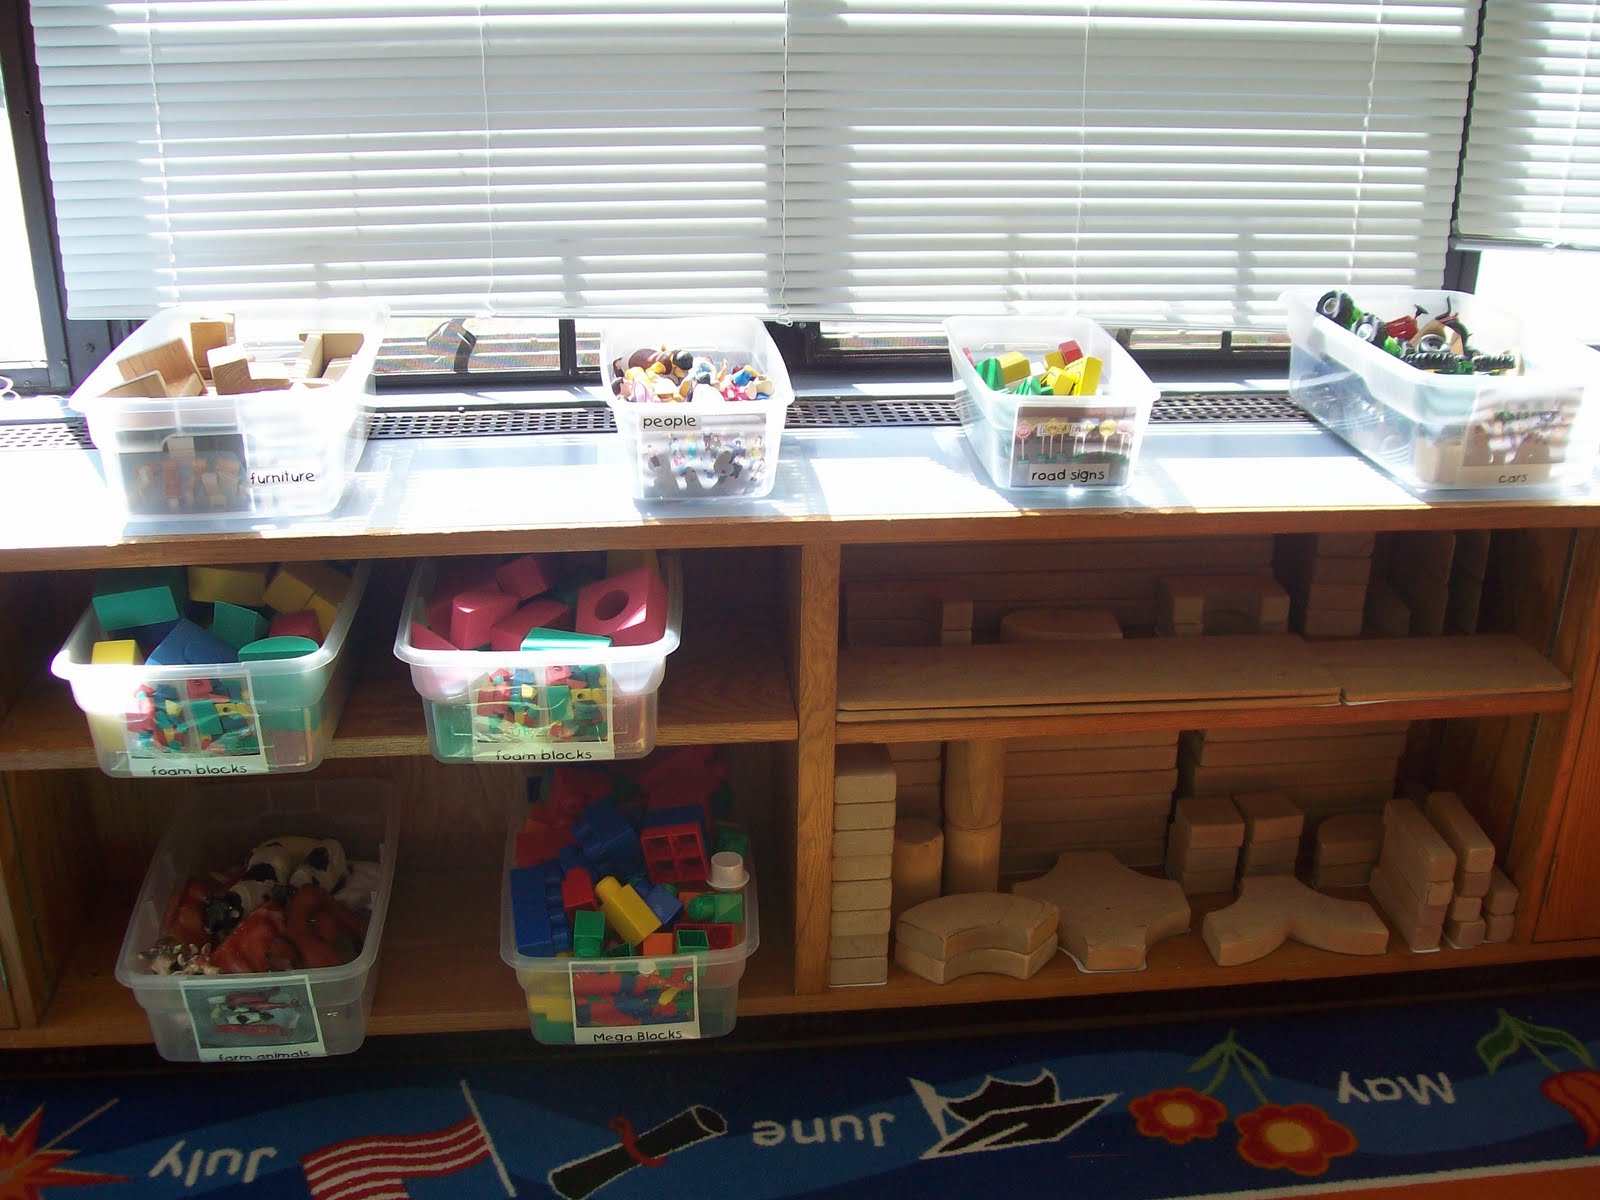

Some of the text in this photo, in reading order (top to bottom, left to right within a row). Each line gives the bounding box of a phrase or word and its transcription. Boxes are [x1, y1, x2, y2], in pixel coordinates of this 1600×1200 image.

[642, 414, 697, 429] people
[250, 470, 316, 485] furniture
[1031, 468, 1105, 483] road signs
[1498, 472, 1529, 484] cars
[495, 749, 593, 761] foam blocks
[151, 764, 248, 776] foam blocks
[593, 1029, 683, 1043] Mega Blocks
[256, 1049, 311, 1061] animals
[1337, 1070, 1457, 1106] May
[752, 1111, 896, 1148] June
[147, 1139, 279, 1188] July
